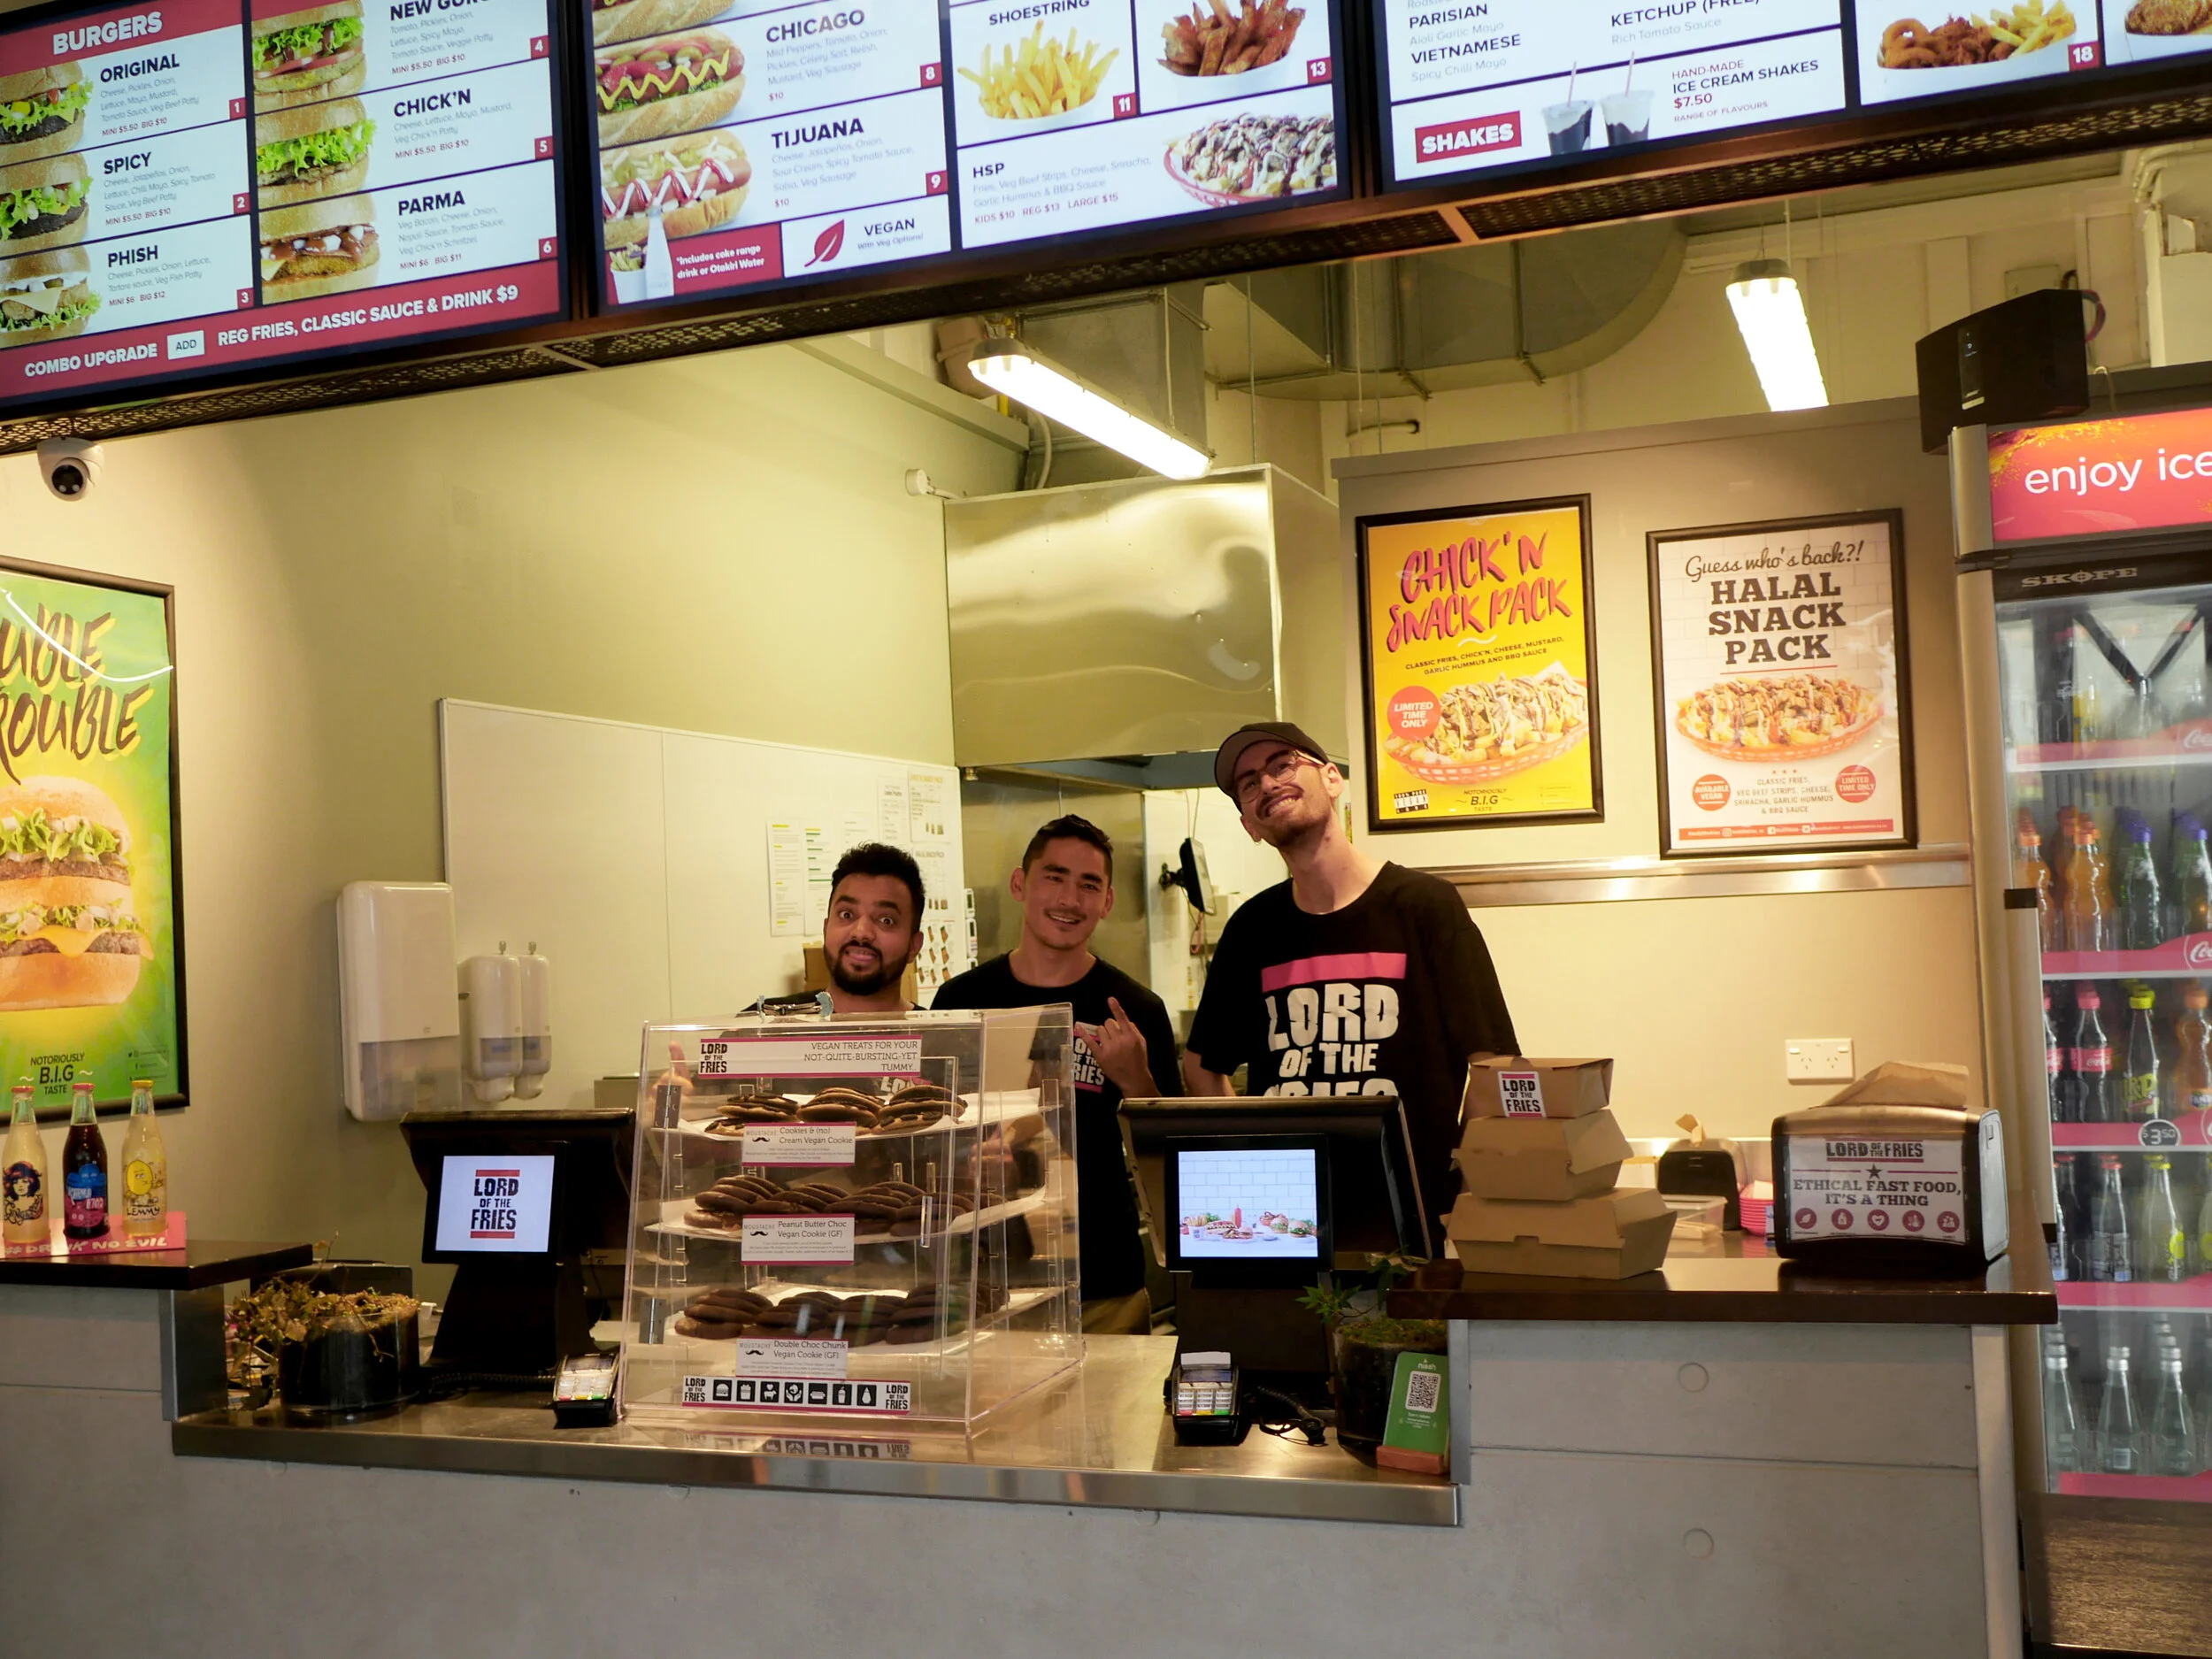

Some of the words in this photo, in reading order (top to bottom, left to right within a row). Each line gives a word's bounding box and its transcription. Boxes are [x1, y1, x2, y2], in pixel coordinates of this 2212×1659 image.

[390, 0, 432, 20] NEW
[989, 0, 1090, 26] SHOESTRING
[1409, 4, 1488, 29] PARISIAN
[1610, 0, 1697, 27] KETCHUP
[53, 12, 163, 55] BURGERS
[766, 9, 865, 42] CHICAGO
[534, 39, 543, 52] 4
[1411, 34, 1521, 65] VIETNAMESE
[2073, 45, 2093, 64] 18
[100, 54, 180, 82] ORIGINAL
[926, 68, 935, 81] 8
[1310, 61, 1326, 76] 13
[1410, 71, 1439, 83] Spicy
[1475, 57, 1507, 73] Mayo
[1671, 59, 1744, 80] HAND-MADE
[1672, 80, 1697, 95] ICE
[1701, 70, 1754, 92] CREAM
[1757, 59, 1819, 81] SHAKES
[394, 88, 472, 118] CHICK'N
[769, 92, 784, 101] $10
[1118, 97, 1131, 112] 11
[1673, 93, 1713, 110] $7.50
[234, 102, 242, 113] 1
[1673, 111, 1704, 124] RANGE
[1707, 109, 1718, 119] OF
[1721, 101, 1769, 116] FLAVOURS
[102, 127, 118, 136] MINI
[119, 123, 138, 134] $5.50
[142, 119, 154, 129] BIG
[155, 117, 167, 126] $10
[771, 118, 864, 150] TIJUANA
[539, 141, 548, 153] 5
[1422, 123, 1514, 155] SHAKES
[104, 152, 151, 174] SPICY
[973, 163, 1005, 179] HSP
[931, 174, 941, 188] 9
[237, 197, 245, 209] 2
[398, 190, 465, 216] PARMA
[775, 198, 789, 209] $10
[974, 211, 996, 224] KIDS
[998, 209, 1015, 220] $10
[1022, 205, 1041, 217] REG
[1044, 202, 1061, 214] $13
[1067, 196, 1100, 210] LARGE
[1102, 193, 1118, 204] $15
[864, 219, 915, 236] VEGAN
[542, 241, 552, 253] 6
[715, 249, 734, 260] coke
[736, 244, 761, 258] range
[857, 242, 874, 250] With
[876, 238, 890, 249] Veg
[108, 245, 158, 267] PHISH
[676, 267, 698, 280] drink
[700, 267, 708, 276] or
[739, 256, 764, 268] Water
[109, 297, 125, 306] MINI
[126, 295, 134, 303] $6
[140, 293, 152, 302] BIG
[153, 290, 165, 300] $12
[241, 292, 250, 303] 3
[25, 356, 81, 377] COMBO
[84, 343, 157, 368] UPGRADE
[175, 339, 196, 351] ADD
[218, 328, 249, 347] REG
[252, 320, 298, 342] FRIES,
[301, 309, 366, 334] CLASSIC
[370, 299, 424, 322] SAUCE
[426, 296, 438, 314] &
[442, 288, 493, 311] DRINK
[496, 284, 518, 303] $9
[2025, 457, 2142, 496] enjoy
[2158, 448, 2212, 481] ice
[1401, 529, 1548, 603] CHICK'N
[1686, 555, 1742, 583] Guess
[1745, 546, 1799, 570] who's
[1801, 540, 1864, 565] back?!
[2022, 567, 2138, 588] SKOPE
[1710, 572, 1841, 605] HALAL
[1386, 592, 1486, 653] SNACK
[1489, 577, 1573, 629] PACK
[1709, 602, 1847, 636] SNACK
[1405, 658, 1435, 670] CLASSIC
[1437, 655, 1460, 665] FRIES,
[1494, 643, 1525, 655] CHEESE,
[1525, 636, 1564, 649] MUSTARD,
[1725, 634, 1831, 664] PACK
[1424, 665, 1450, 676] GARLIC
[1452, 659, 1486, 671] HUMMUS
[1487, 656, 1503, 664] AND
[1505, 652, 1521, 662] BBQ
[1522, 648, 1548, 658] SAUCE
[1394, 701, 1433, 712] LIMITED
[1402, 710, 1426, 720] TIME
[1402, 718, 1428, 729] ONLY
[1841, 776, 1870, 785] LIMITED
[1857, 782, 1875, 791] ONLY
[1471, 795, 1498, 806] B.I.G
[1264, 982, 1399, 1052] LORD
[701, 1043, 727, 1055] LORD
[842, 1041, 873, 1050] TREATS
[893, 1041, 918, 1049] YOUR
[30, 1052, 85, 1066] NOTORIOUSLY
[803, 1052, 918, 1062] NOT-QUITE-BURSTING-YET
[1279, 1047, 1313, 1079] OF
[1319, 1042, 1379, 1074] THE
[39, 1064, 74, 1085] B.I.G
[700, 1061, 727, 1073] FRIES
[1073, 1062, 1105, 1086] RIES
[44, 1084, 67, 1096] TASTE
[1502, 1079, 1535, 1092] LORD
[1506, 1099, 1540, 1113] FRIES
[780, 1126, 808, 1135] Cookies
[816, 1126, 831, 1136] (no)
[804, 1137, 826, 1146] Vegan
[1826, 1142, 1869, 1157] LORD
[1885, 1142, 1923, 1157] FRIES
[473, 1178, 518, 1196] LORD
[1793, 1179, 1863, 1192] ETHICAL
[1866, 1180, 1909, 1192] FAST
[1914, 1181, 1962, 1195] FOOD,
[480, 1198, 491, 1208] OF
[494, 1198, 511, 1208] THE
[1825, 1194, 1856, 1205] IT'S
[1861, 1194, 1873, 1205] A
[1877, 1194, 1929, 1207] THING
[471, 1209, 517, 1230] FRIES
[828, 1230, 842, 1239] (GF)
[773, 1340, 799, 1348] Double
[886, 1385, 908, 1394] LORD
[885, 1399, 908, 1409] FRIES
